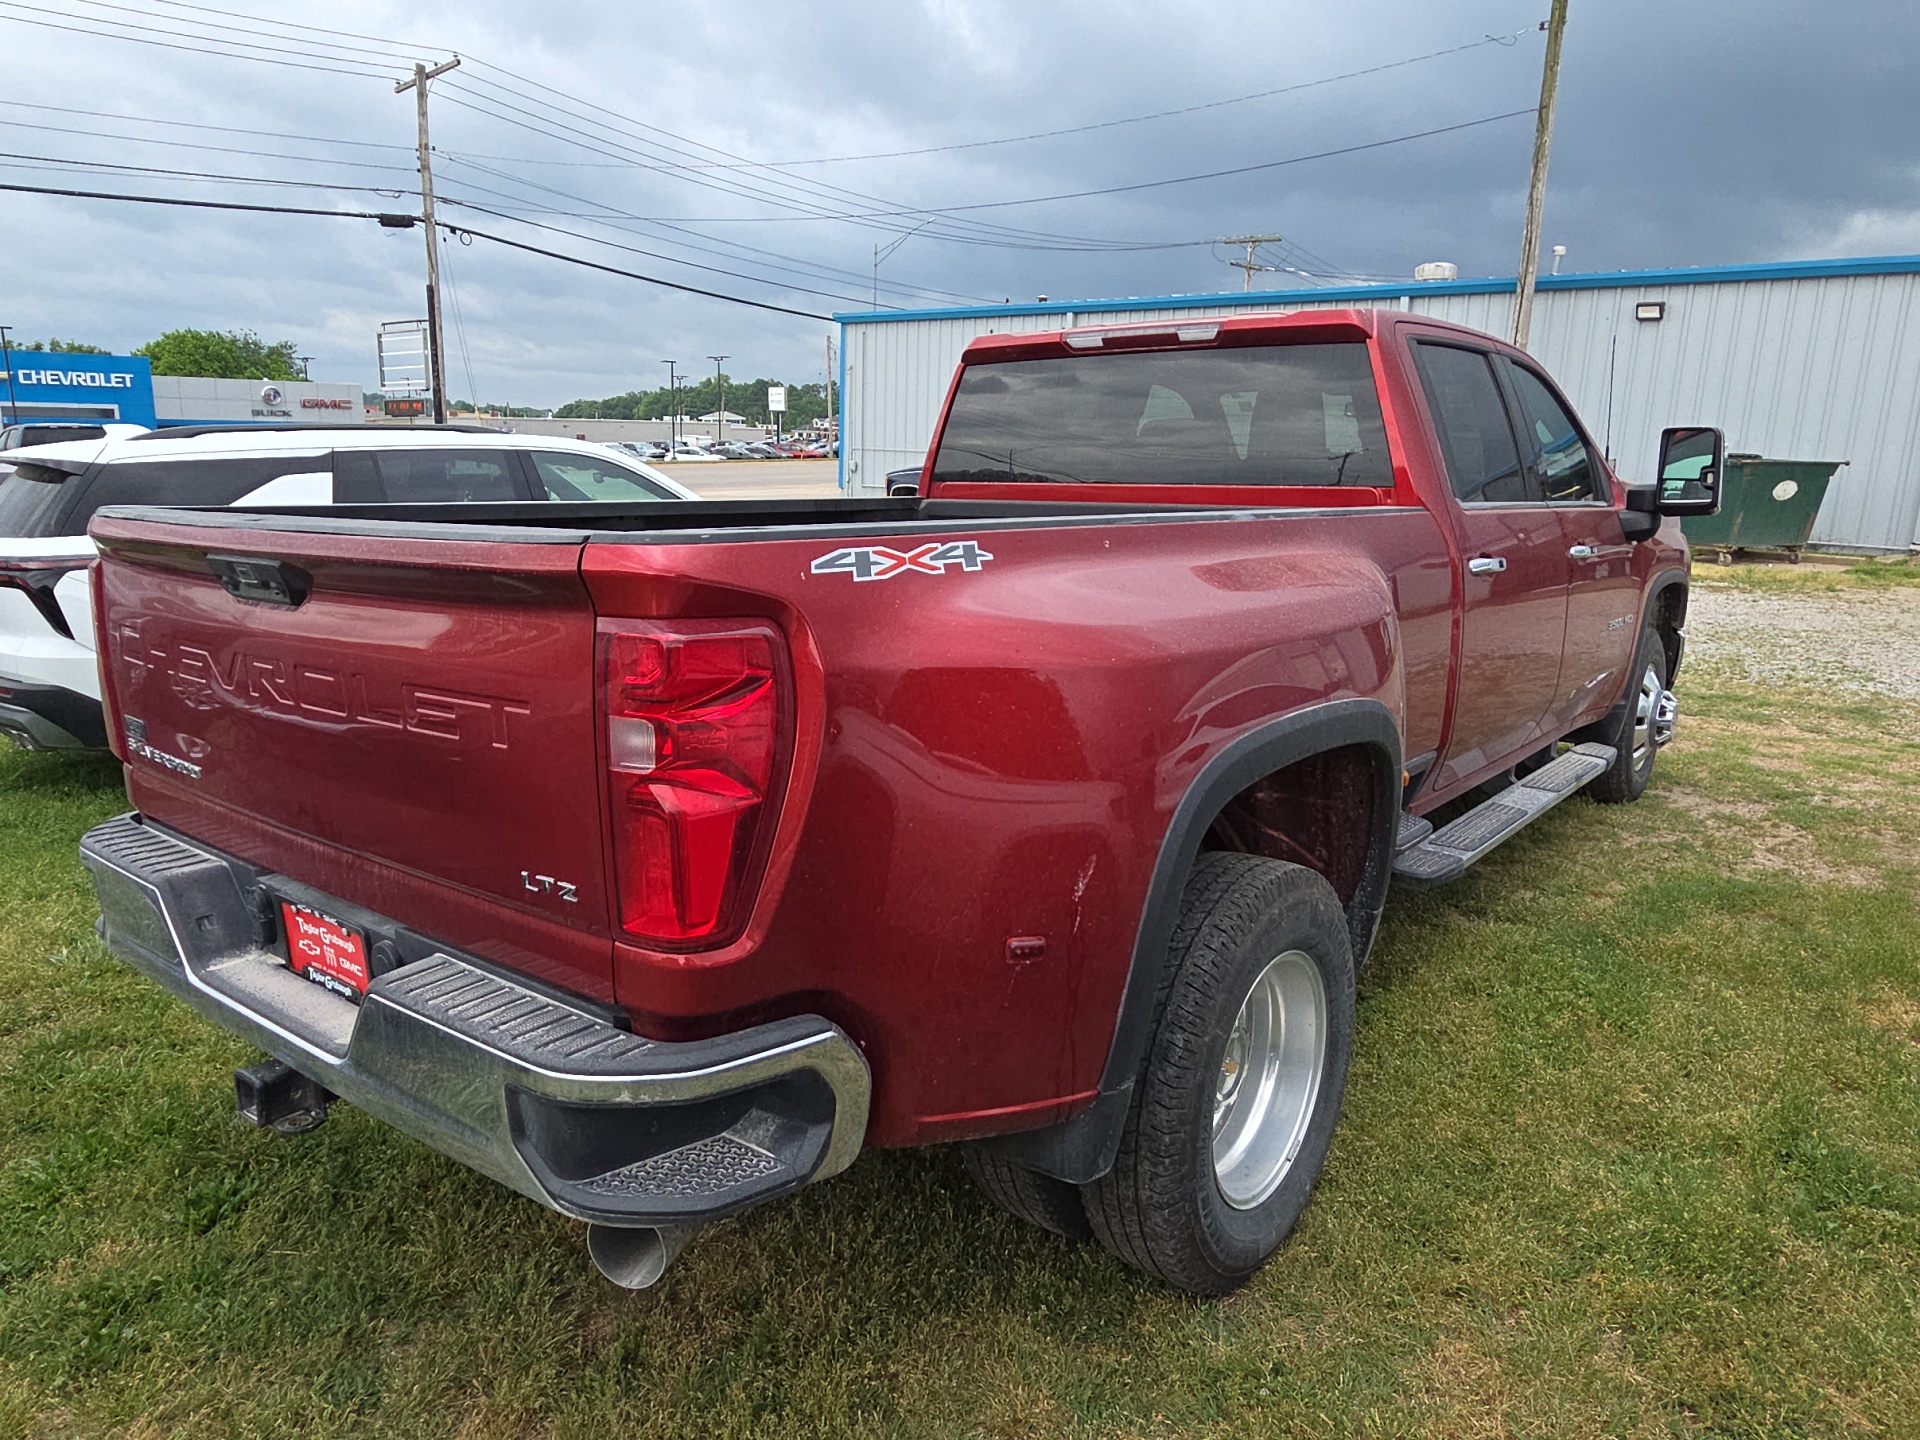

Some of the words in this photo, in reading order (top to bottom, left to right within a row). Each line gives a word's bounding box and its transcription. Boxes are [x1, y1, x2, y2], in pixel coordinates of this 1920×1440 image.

[18, 369, 134, 388] CHEVROLET
[251, 409, 292, 417] BUICK
[301, 398, 352, 410] GMC
[520, 870, 578, 902] LTZ
[339, 957, 363, 977] GMC
